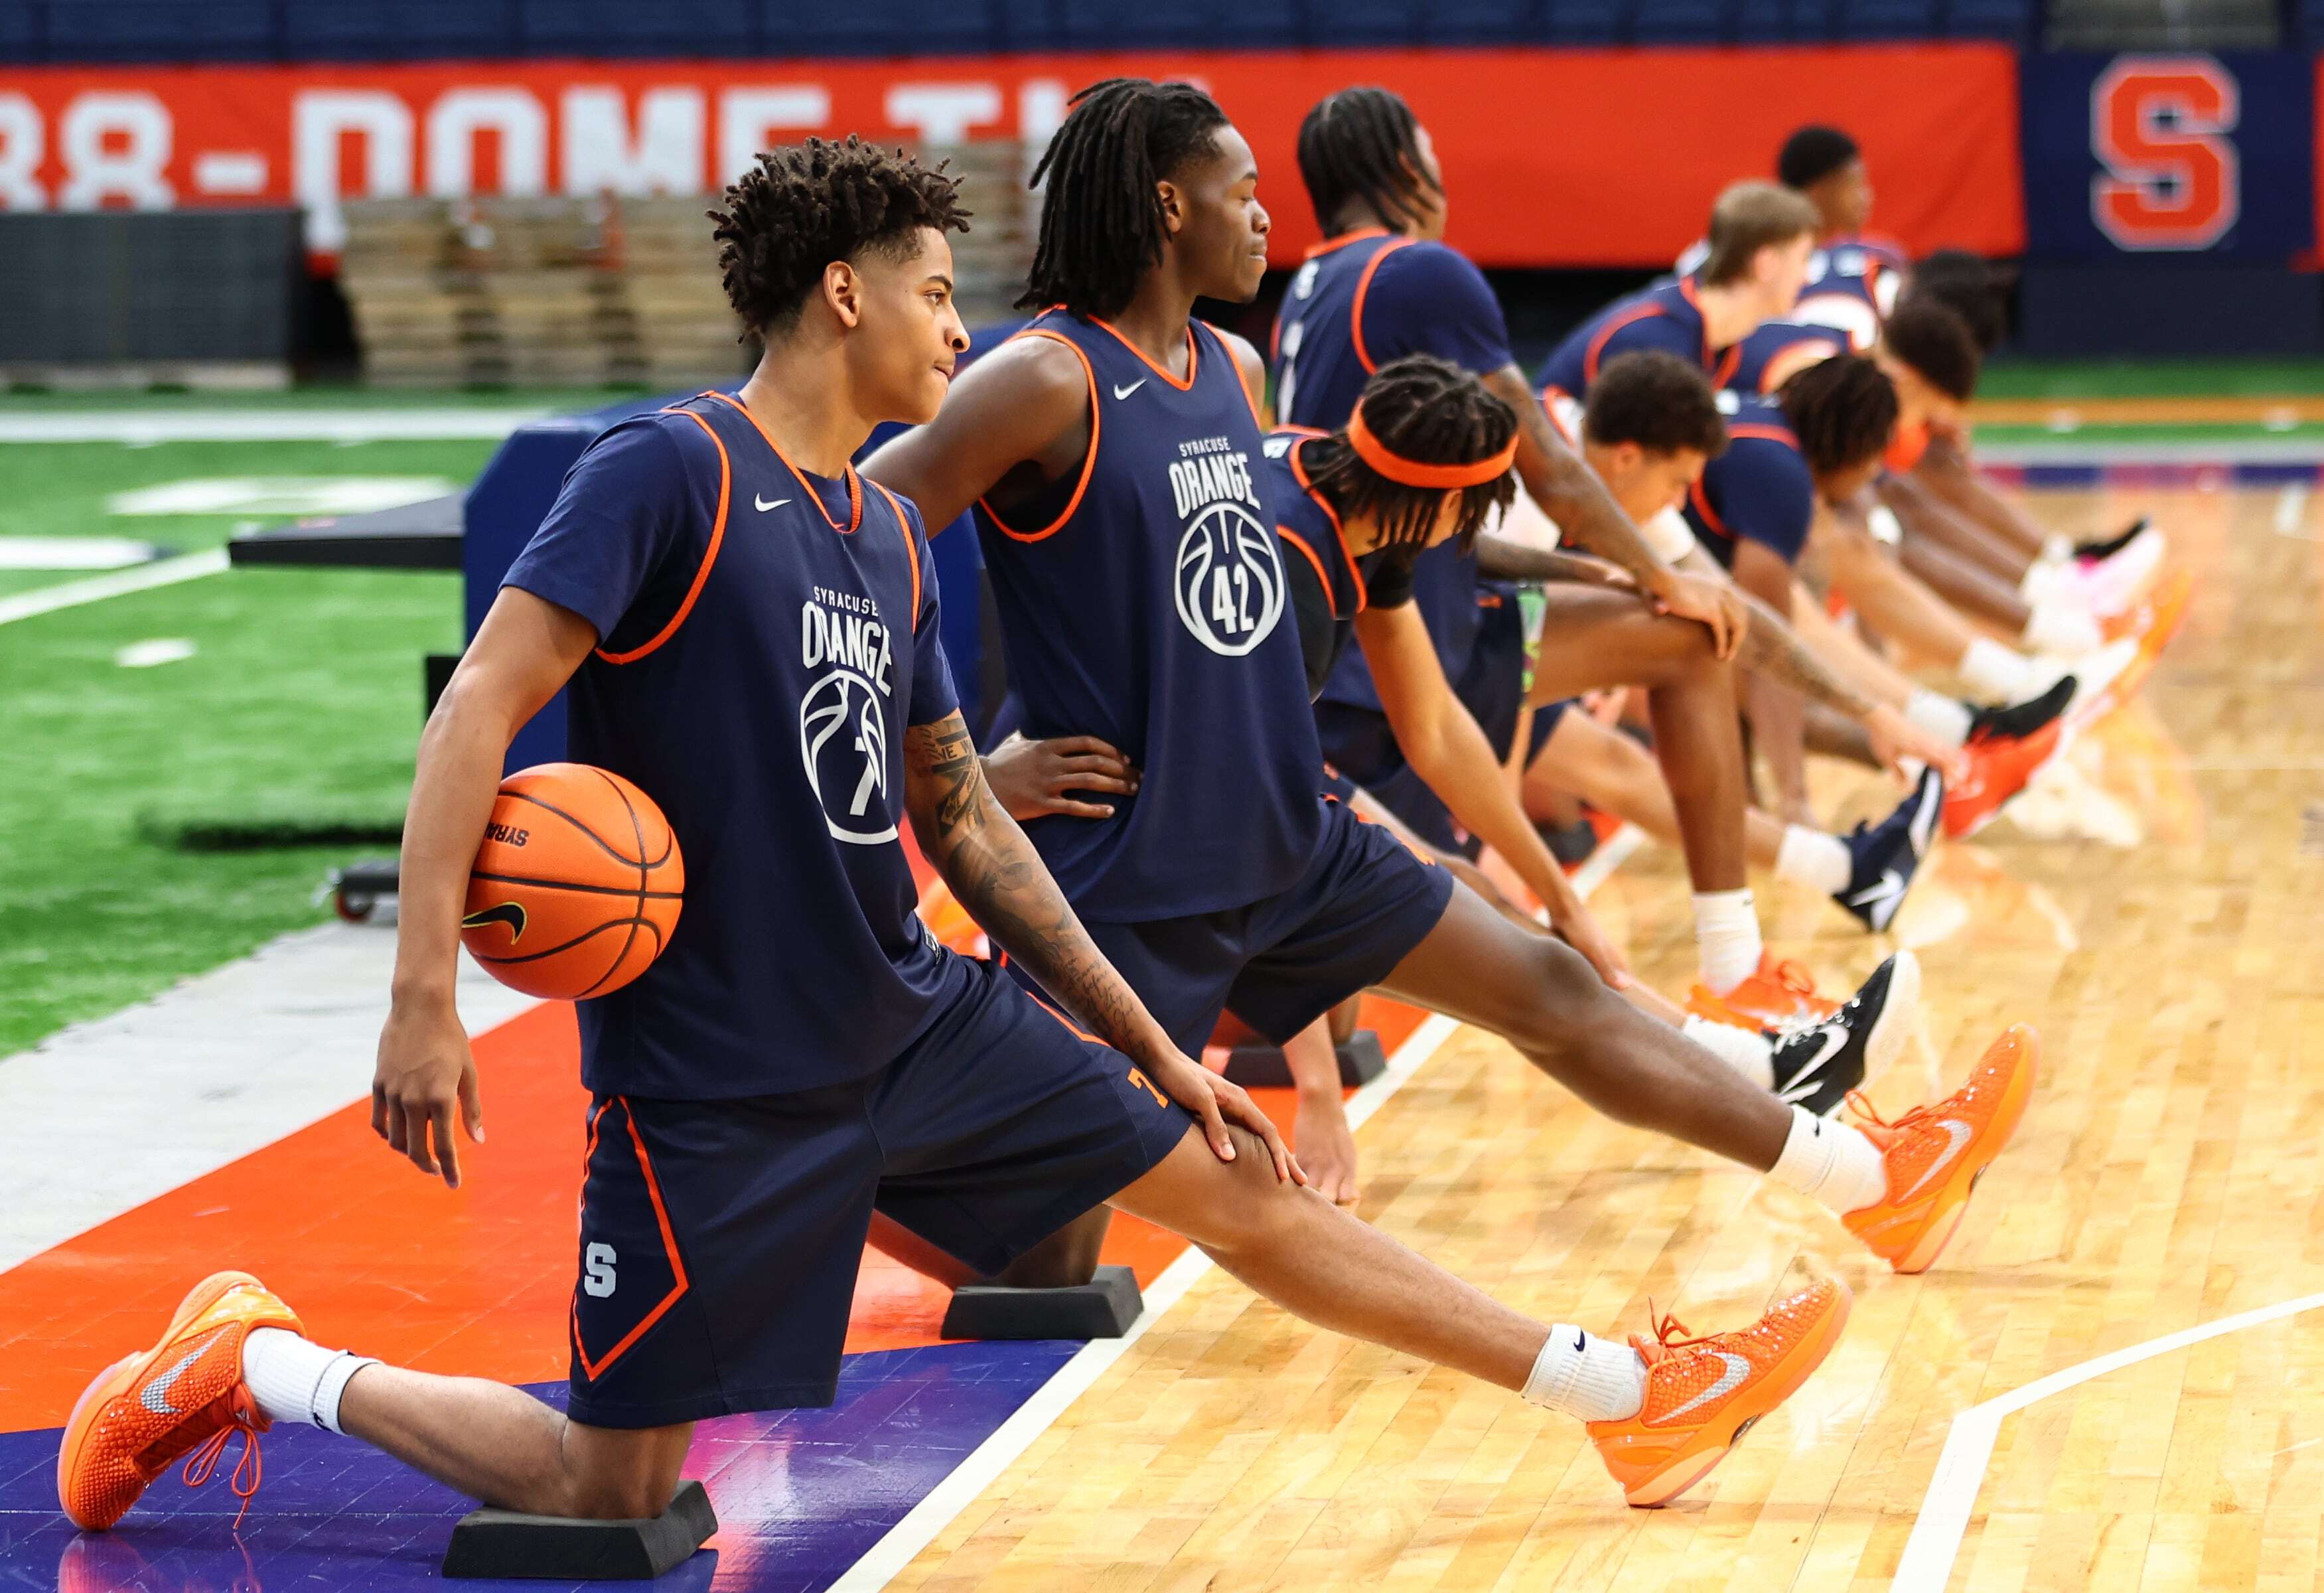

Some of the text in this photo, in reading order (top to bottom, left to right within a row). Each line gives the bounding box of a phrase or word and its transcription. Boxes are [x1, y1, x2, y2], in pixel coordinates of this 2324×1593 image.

[2090, 52, 2242, 252] S
[1179, 436, 1232, 458] SYRACUSE
[1168, 452, 1262, 520] ORANGE
[814, 585, 879, 618] SYRACUSE
[1212, 563, 1255, 635] 42
[849, 737, 876, 816] 7
[1127, 1067, 1169, 1109] 7
[584, 1241, 617, 1298] S
